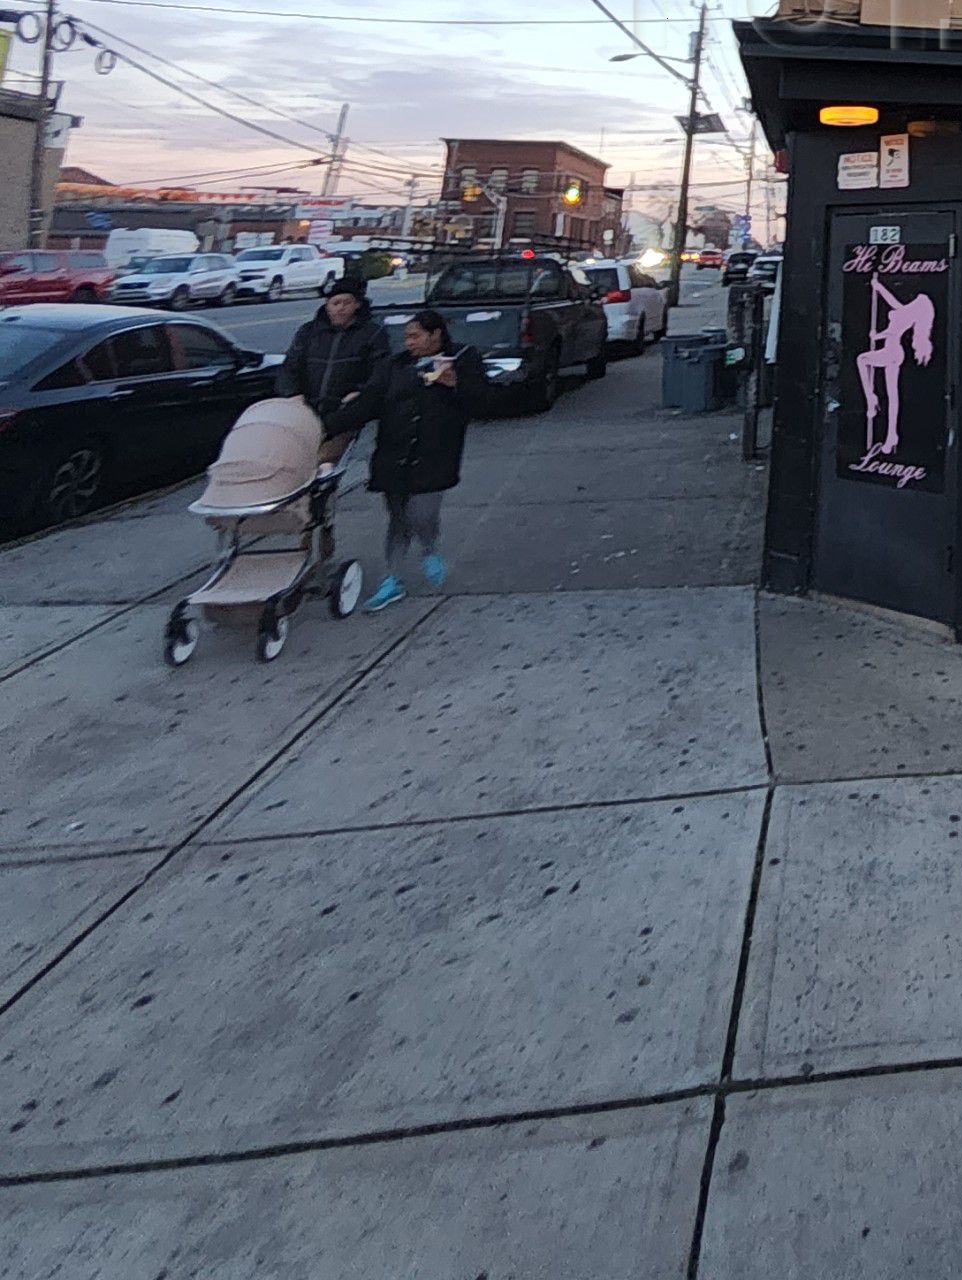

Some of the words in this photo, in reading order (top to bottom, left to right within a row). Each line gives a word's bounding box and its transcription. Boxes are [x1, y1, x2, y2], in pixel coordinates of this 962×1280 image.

[842, 244, 878, 272] Hi
[877, 244, 949, 273] Beams
[848, 442, 927, 488] Lounge
